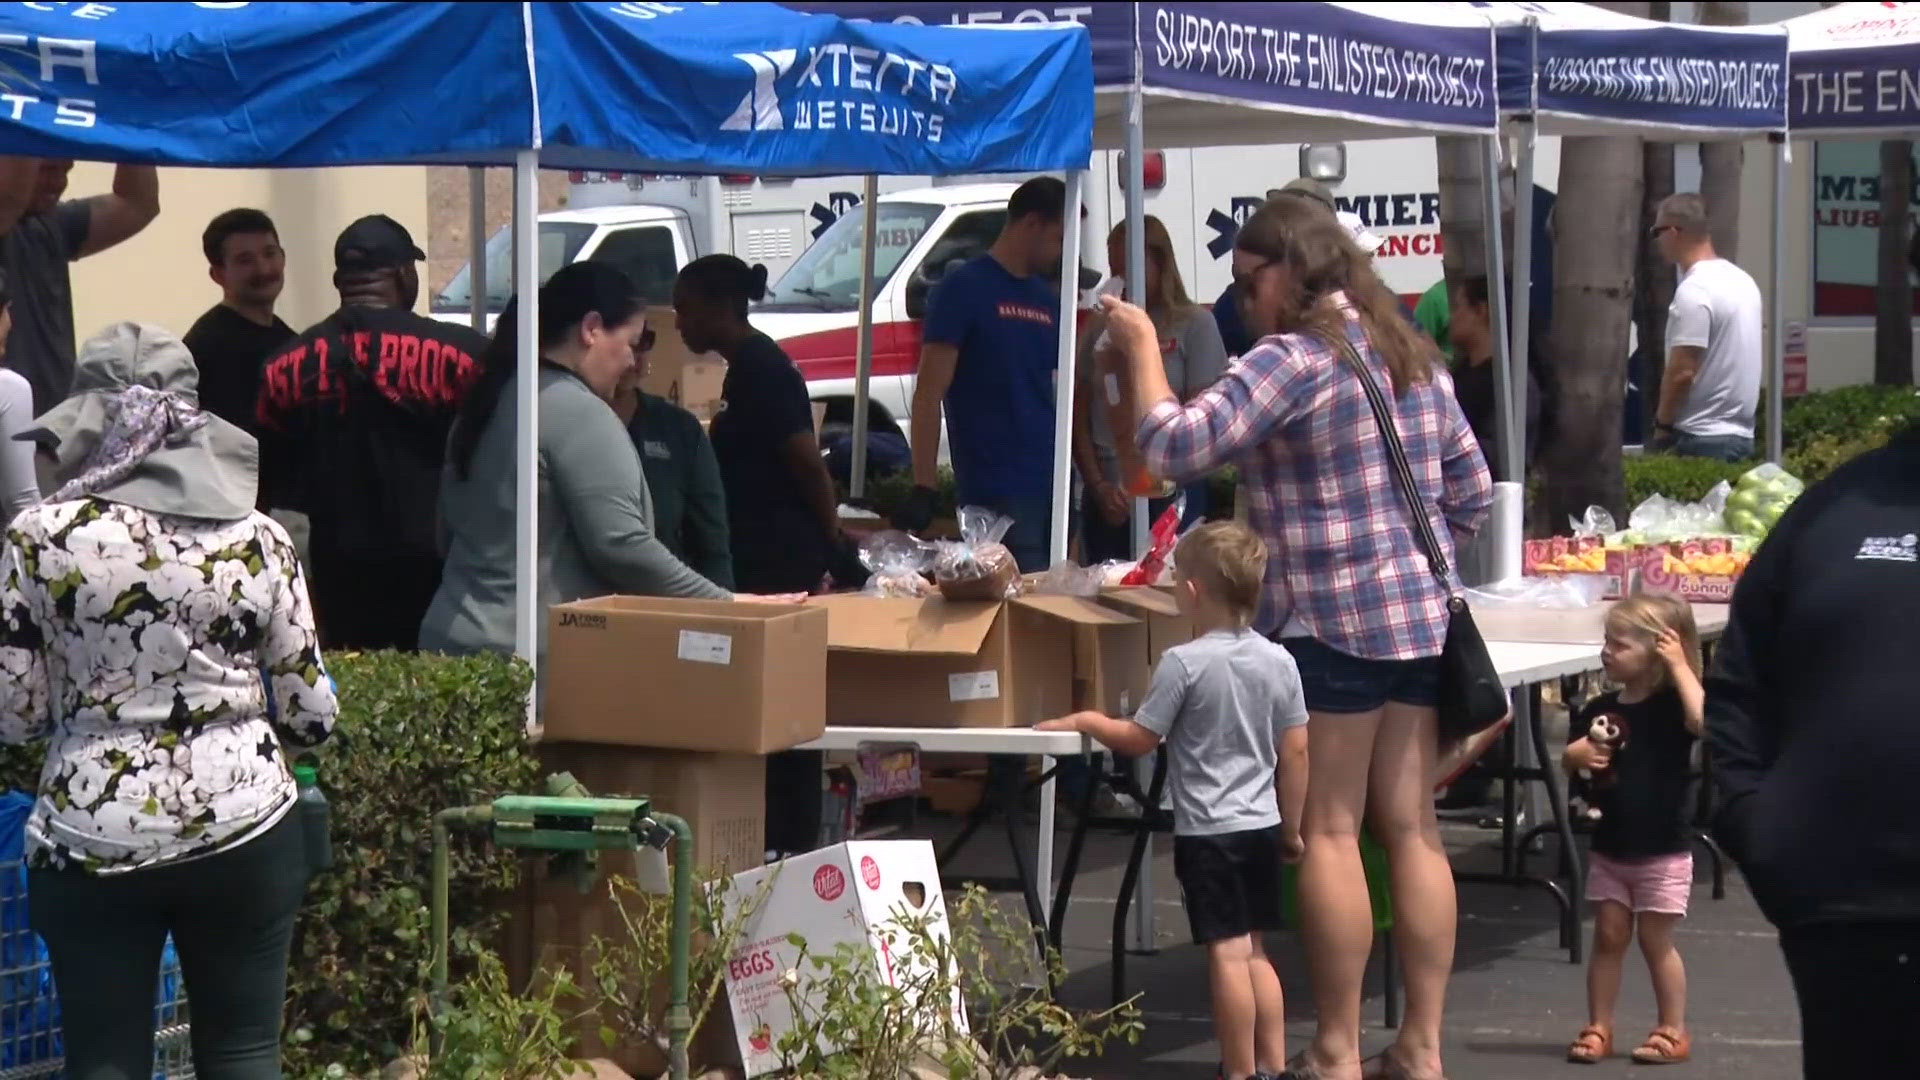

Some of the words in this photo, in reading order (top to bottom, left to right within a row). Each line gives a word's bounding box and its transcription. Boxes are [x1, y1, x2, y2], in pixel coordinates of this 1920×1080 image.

[1156, 9, 1257, 81] SUPPORT
[1261, 28, 1301, 87] THE
[1306, 35, 1401, 99] ENLISTED
[1400, 50, 1485, 109] PROJECT
[1650, 57, 1719, 107] ENLISTED
[1718, 61, 1780, 109] PROJECT
[1794, 71, 1864, 115] THE
[793, 100, 944, 143] WETSUITS
[1231, 192, 1441, 229] PMIER
[729, 950, 775, 981] EGGS
